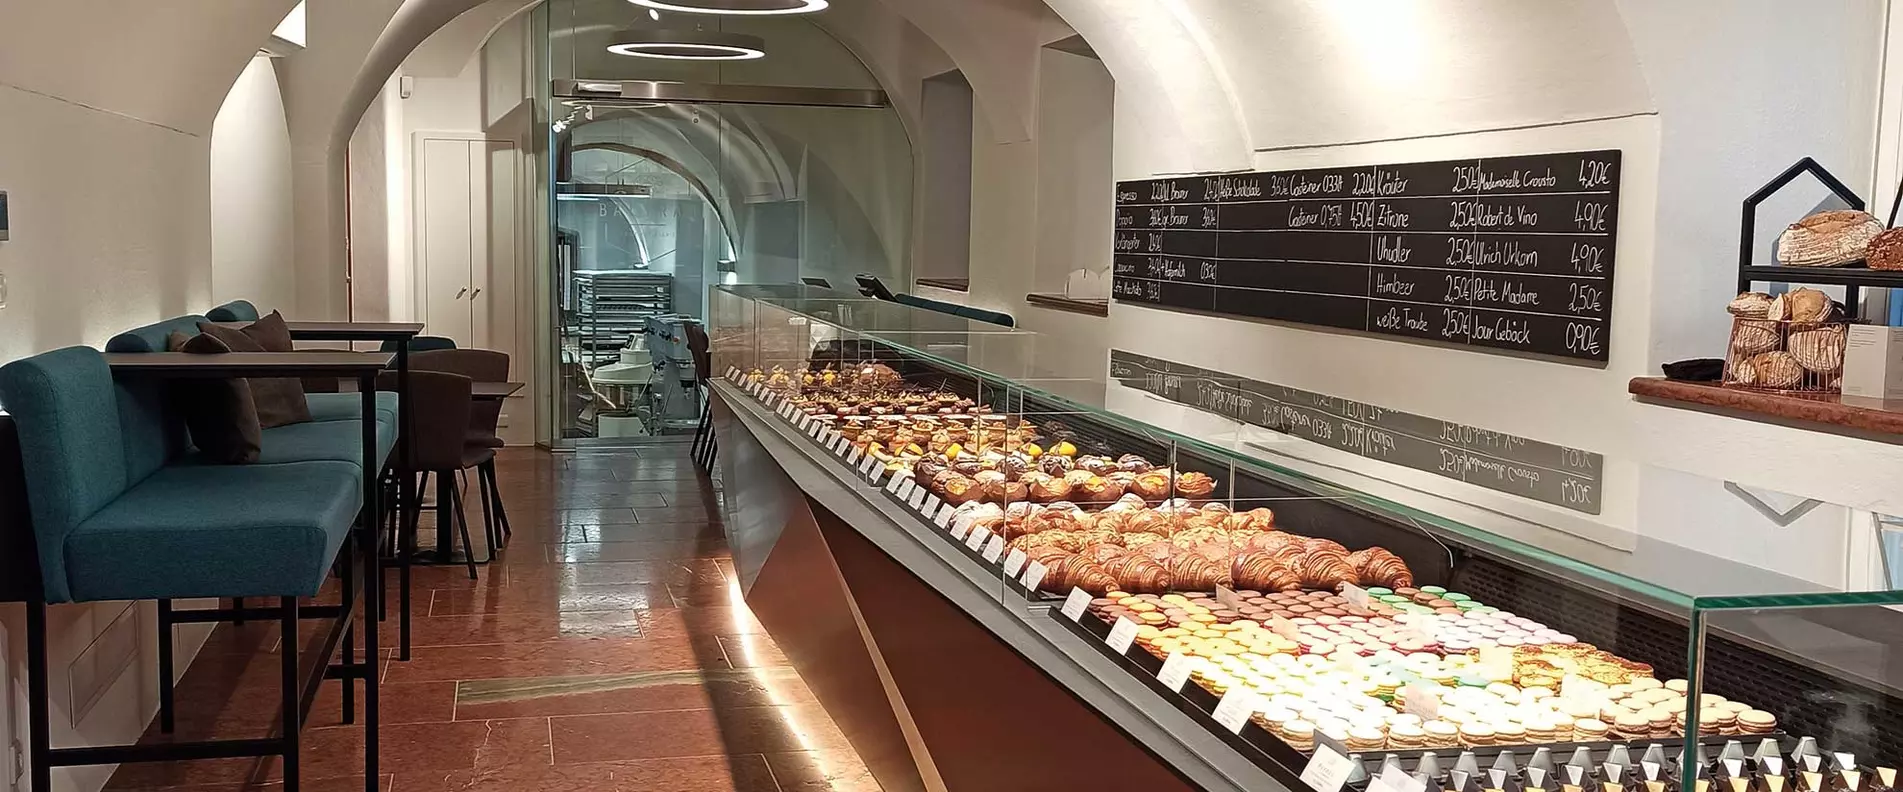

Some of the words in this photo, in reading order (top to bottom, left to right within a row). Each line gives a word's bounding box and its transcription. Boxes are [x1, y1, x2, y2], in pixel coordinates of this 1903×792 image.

[1377, 169, 1409, 196] Kräuter
[1479, 169, 1522, 190] Mademoiselle
[1578, 159, 1612, 189] 4,20€
[1377, 204, 1409, 228] Zitrone
[1450, 201, 1477, 230] 2,50€
[1477, 203, 1504, 227] Robert
[1504, 204, 1515, 227] de
[1517, 204, 1538, 227] Vino
[1574, 200, 1609, 232] 4,90€
[1377, 235, 1412, 263] Uhudler
[1447, 236, 1474, 266] 2,50€
[1475, 240, 1501, 266] Ulrich
[1571, 242, 1605, 274] 4,90€
[1376, 272, 1415, 296] Himbeer
[1444, 274, 1472, 304] 2,50€
[1473, 277, 1499, 302] Petite
[1501, 280, 1540, 306] Madame
[1568, 282, 1603, 315] 2,50€
[1376, 306, 1401, 330] weiße
[1402, 307, 1428, 332] Traube
[1441, 307, 1470, 339] 2,50€
[1471, 314, 1494, 340] Jour
[1495, 317, 1531, 344] Gebäck
[1565, 322, 1600, 356] 0,90€
